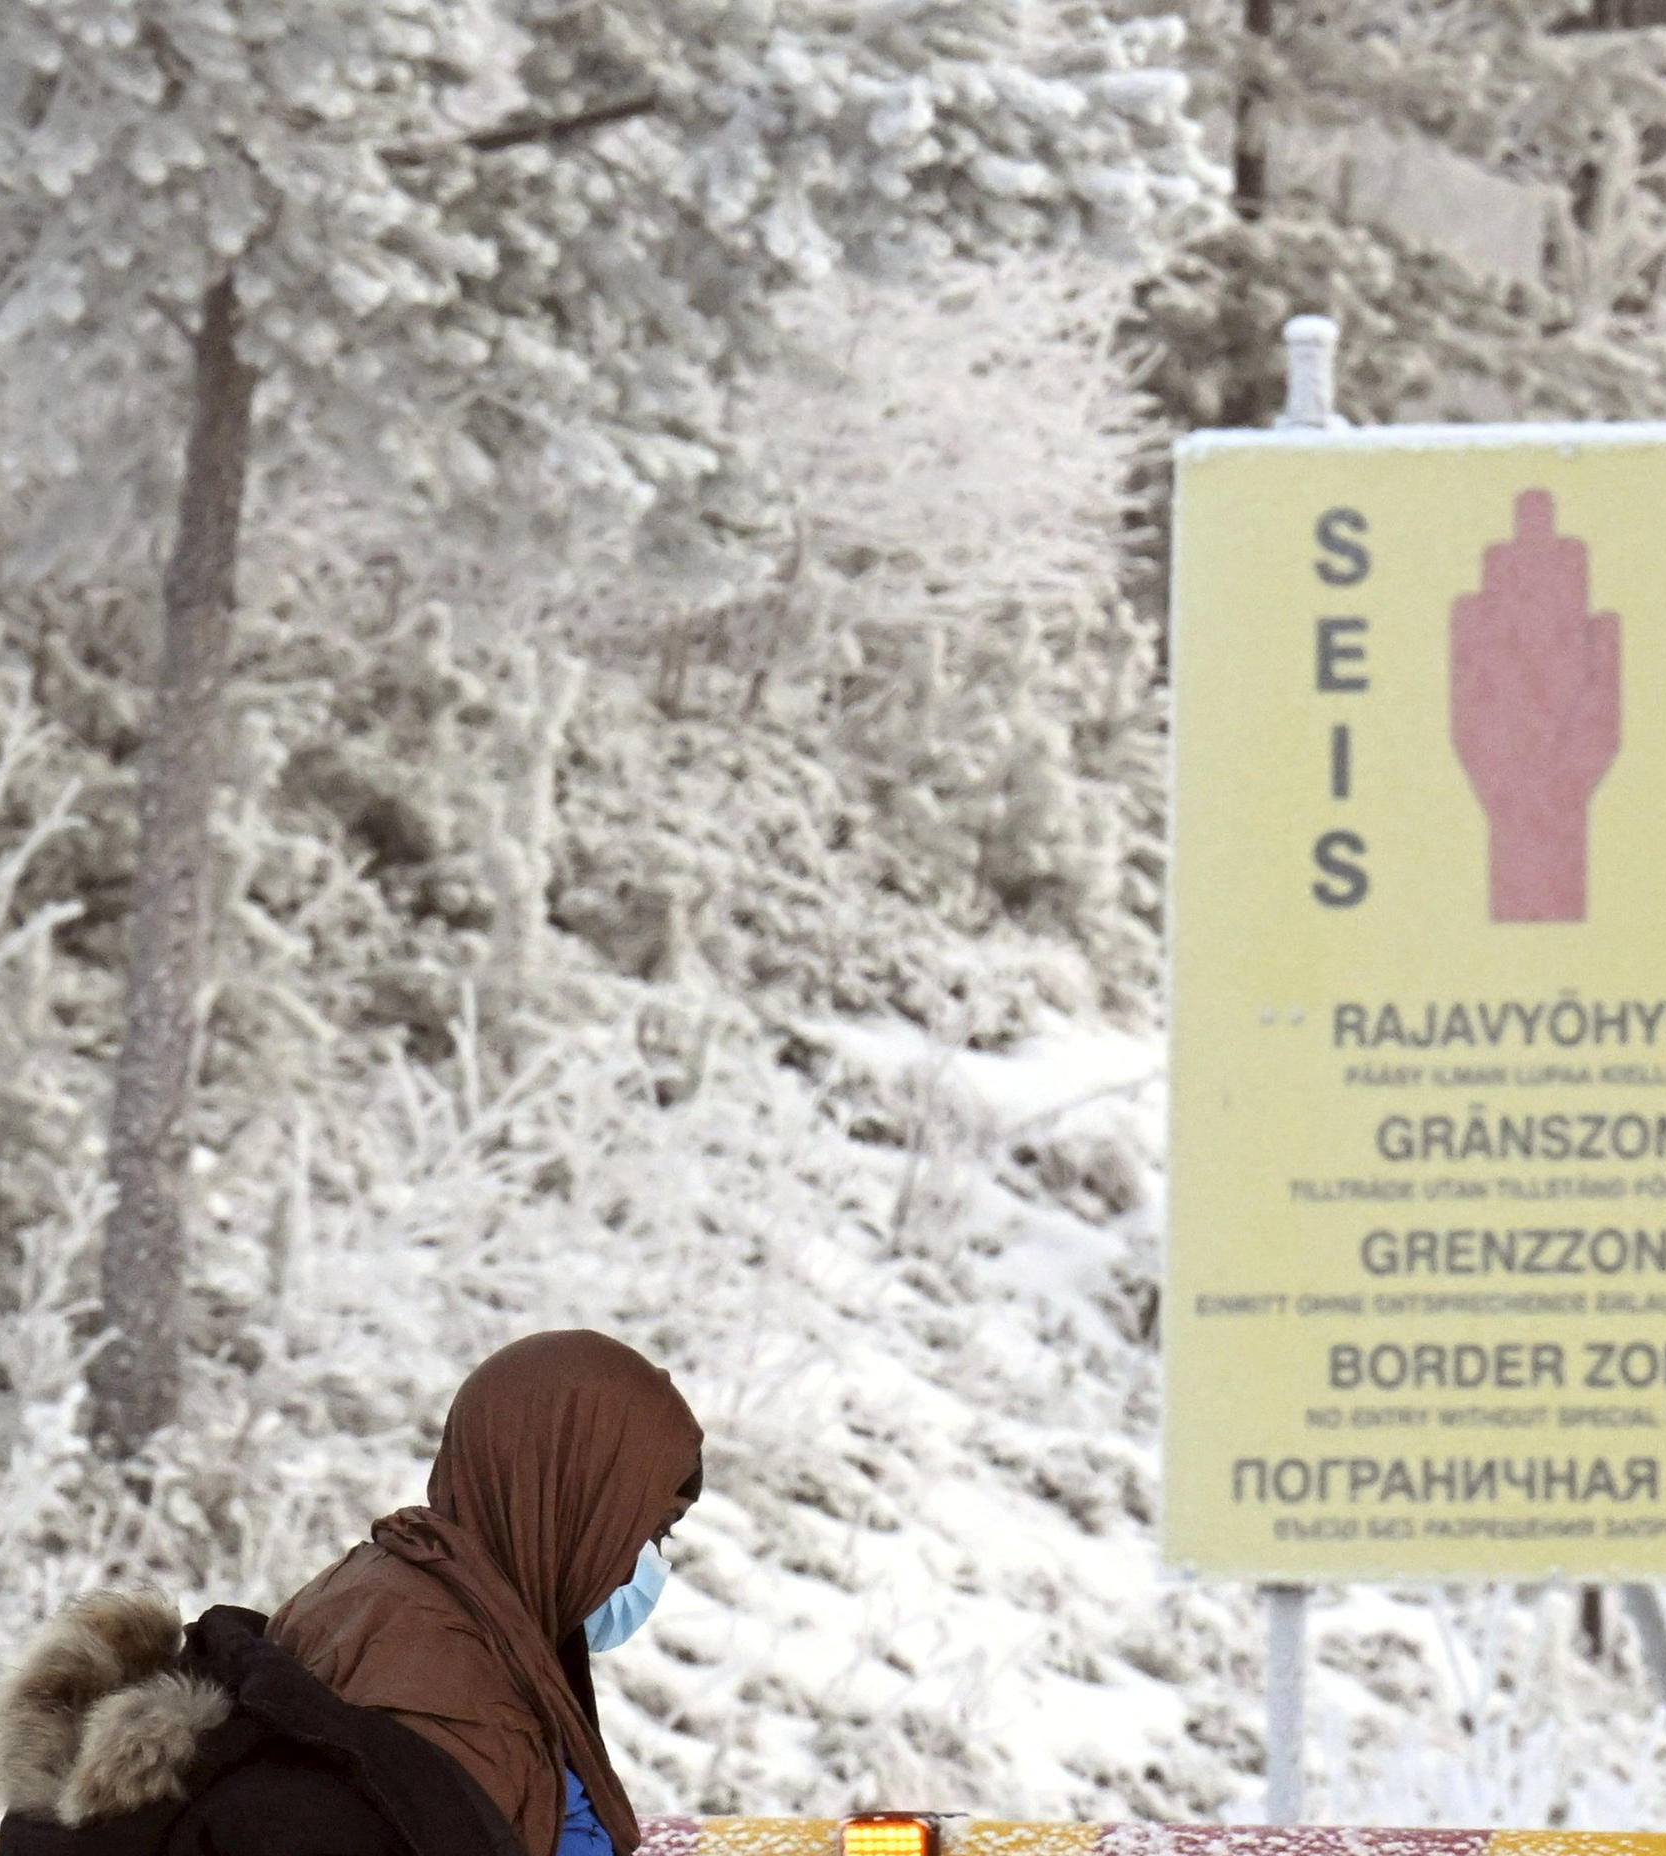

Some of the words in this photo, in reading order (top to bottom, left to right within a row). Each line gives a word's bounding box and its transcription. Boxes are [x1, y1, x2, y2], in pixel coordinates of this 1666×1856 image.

[1309, 507, 1371, 909] SEIS
[1328, 1342, 1565, 1390] BORDER
[1305, 1407, 1343, 1430] NO
[1349, 1406, 1429, 1429] ENTRY
[1437, 1406, 1548, 1429] WITHOUT
[1556, 1406, 1660, 1429] SPECIAL
[1232, 1457, 1660, 1504] ПОГРАНИЧНАЯ
